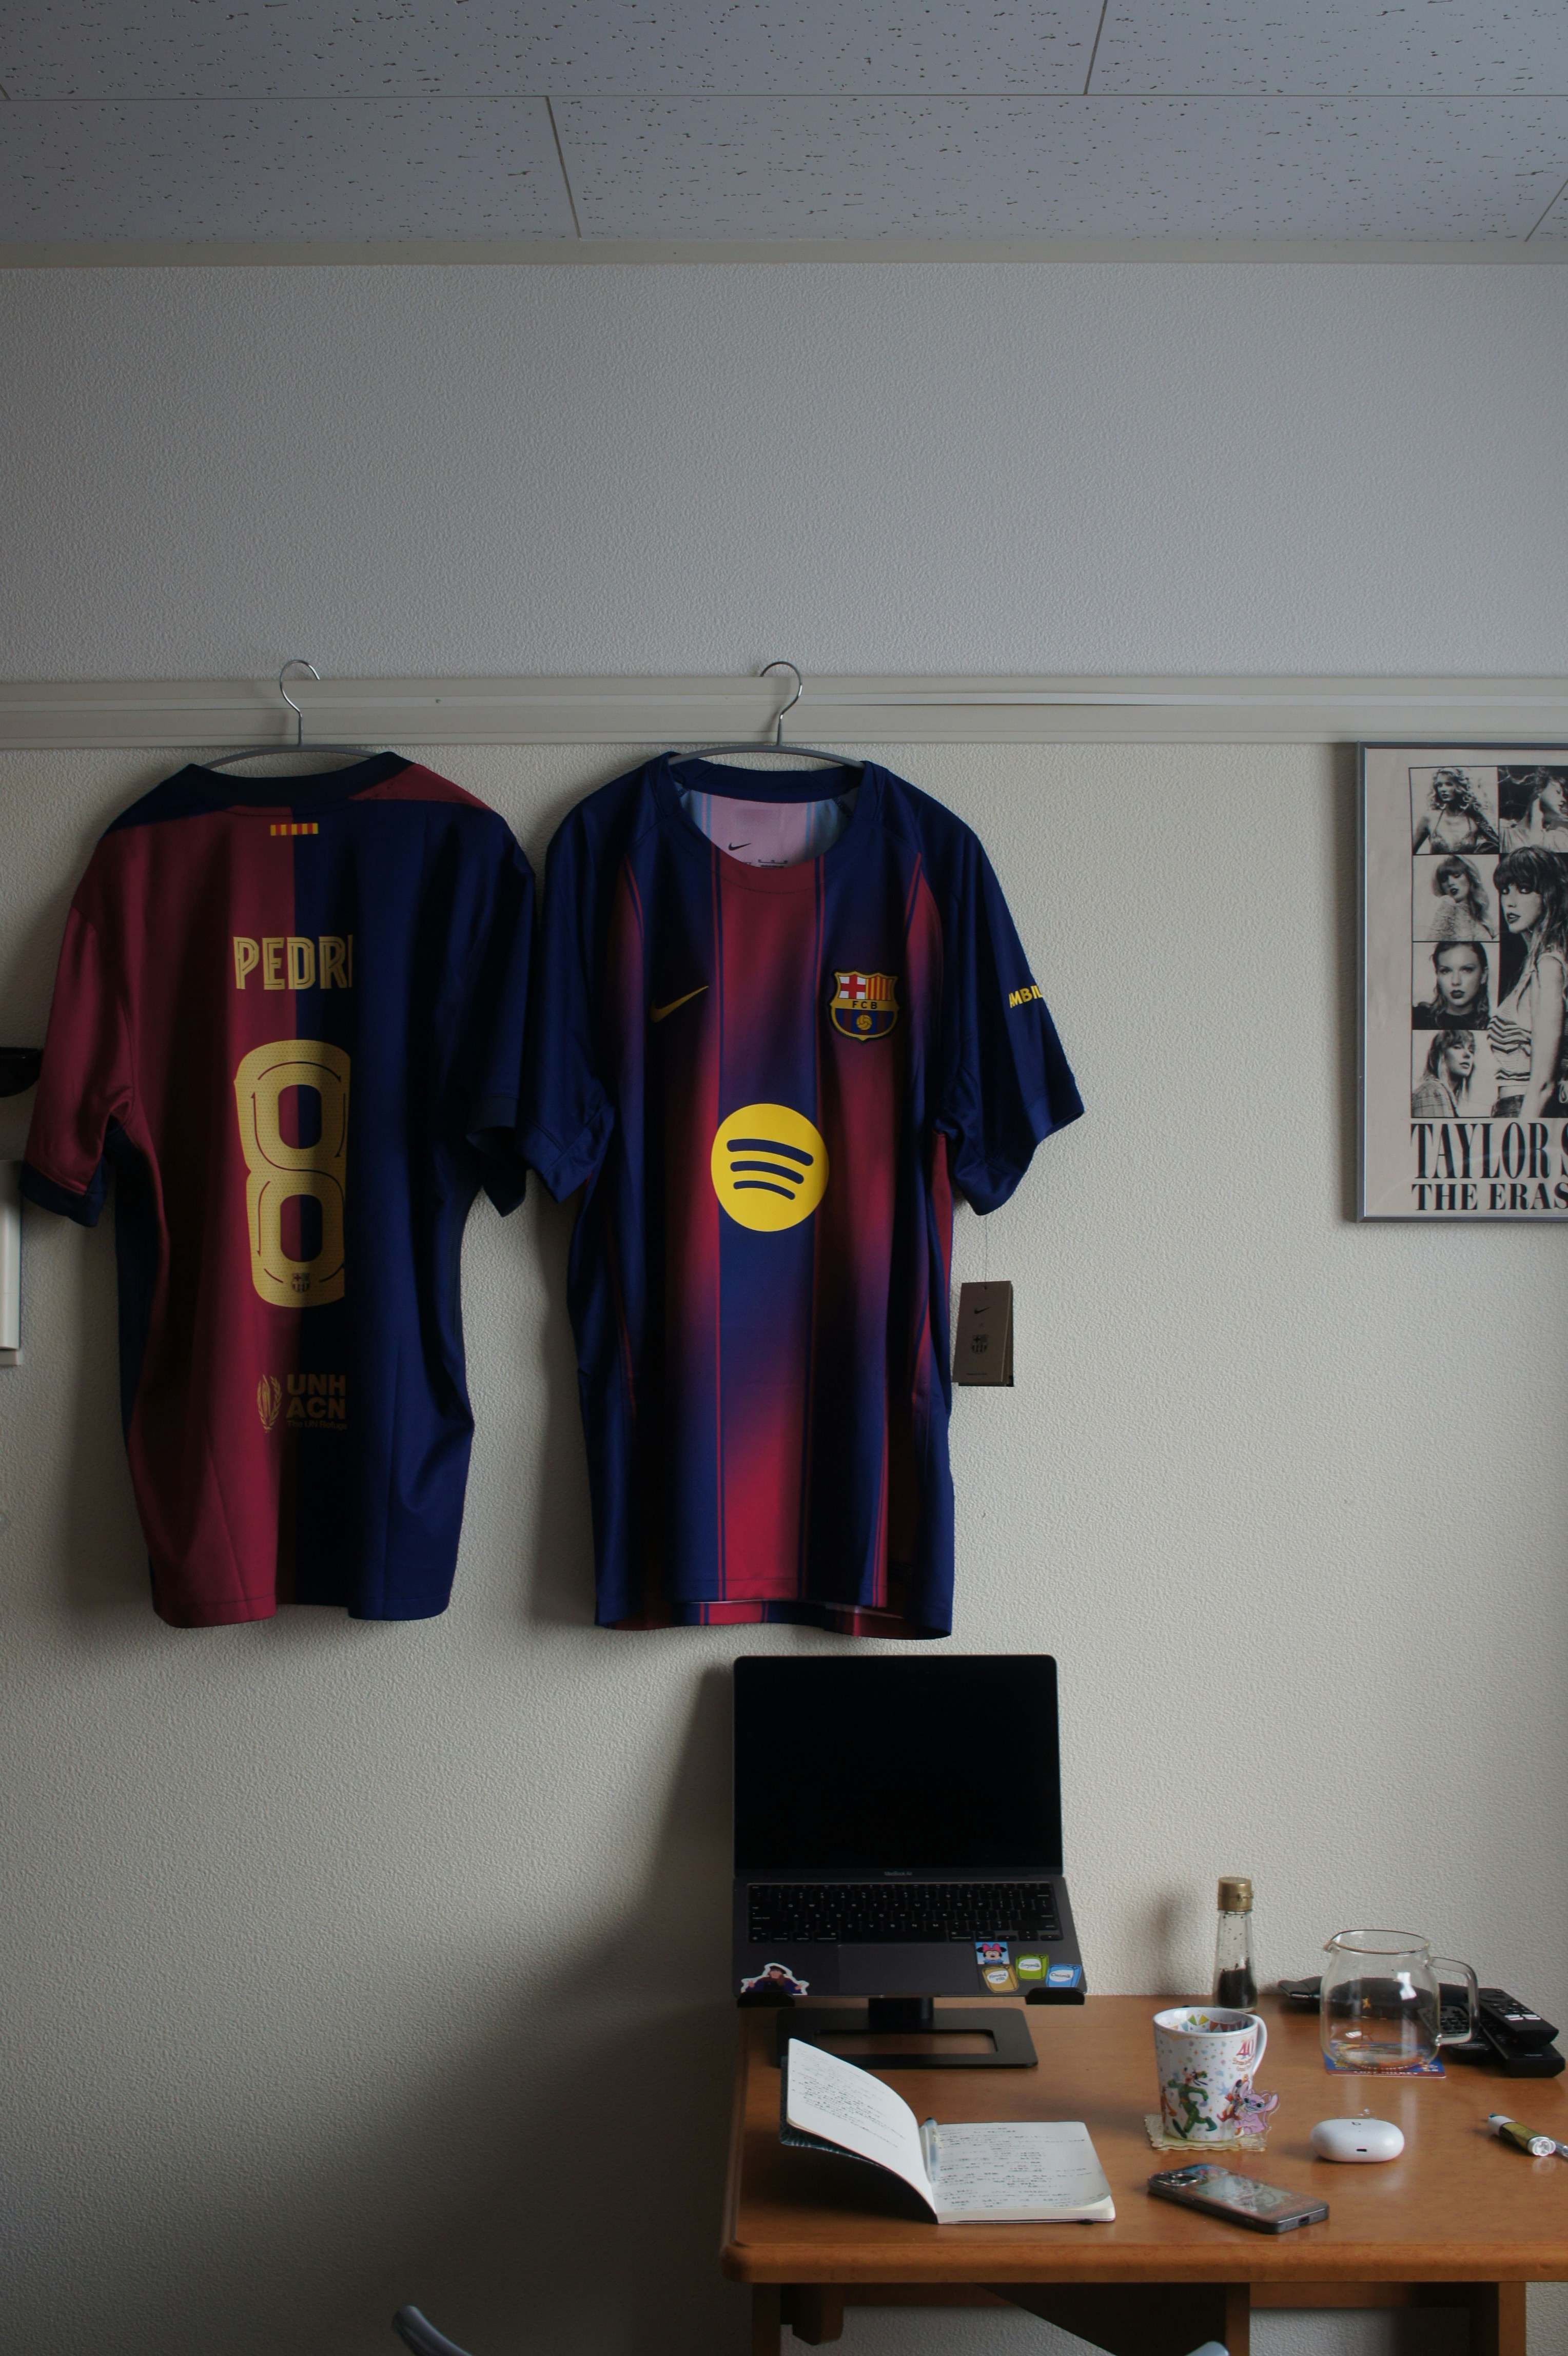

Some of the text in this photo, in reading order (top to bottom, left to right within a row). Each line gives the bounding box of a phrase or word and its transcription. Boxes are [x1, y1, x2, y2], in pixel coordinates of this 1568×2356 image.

[233, 934, 353, 990] PEDRI
[852, 1000, 877, 1009] FCB
[1410, 1122, 1550, 1179] TAYLOR
[233, 1039, 351, 1308] 8
[1412, 1182, 1568, 1211] THE ERAS
[287, 1373, 346, 1396] UNH
[286, 1396, 346, 1420] ACN
